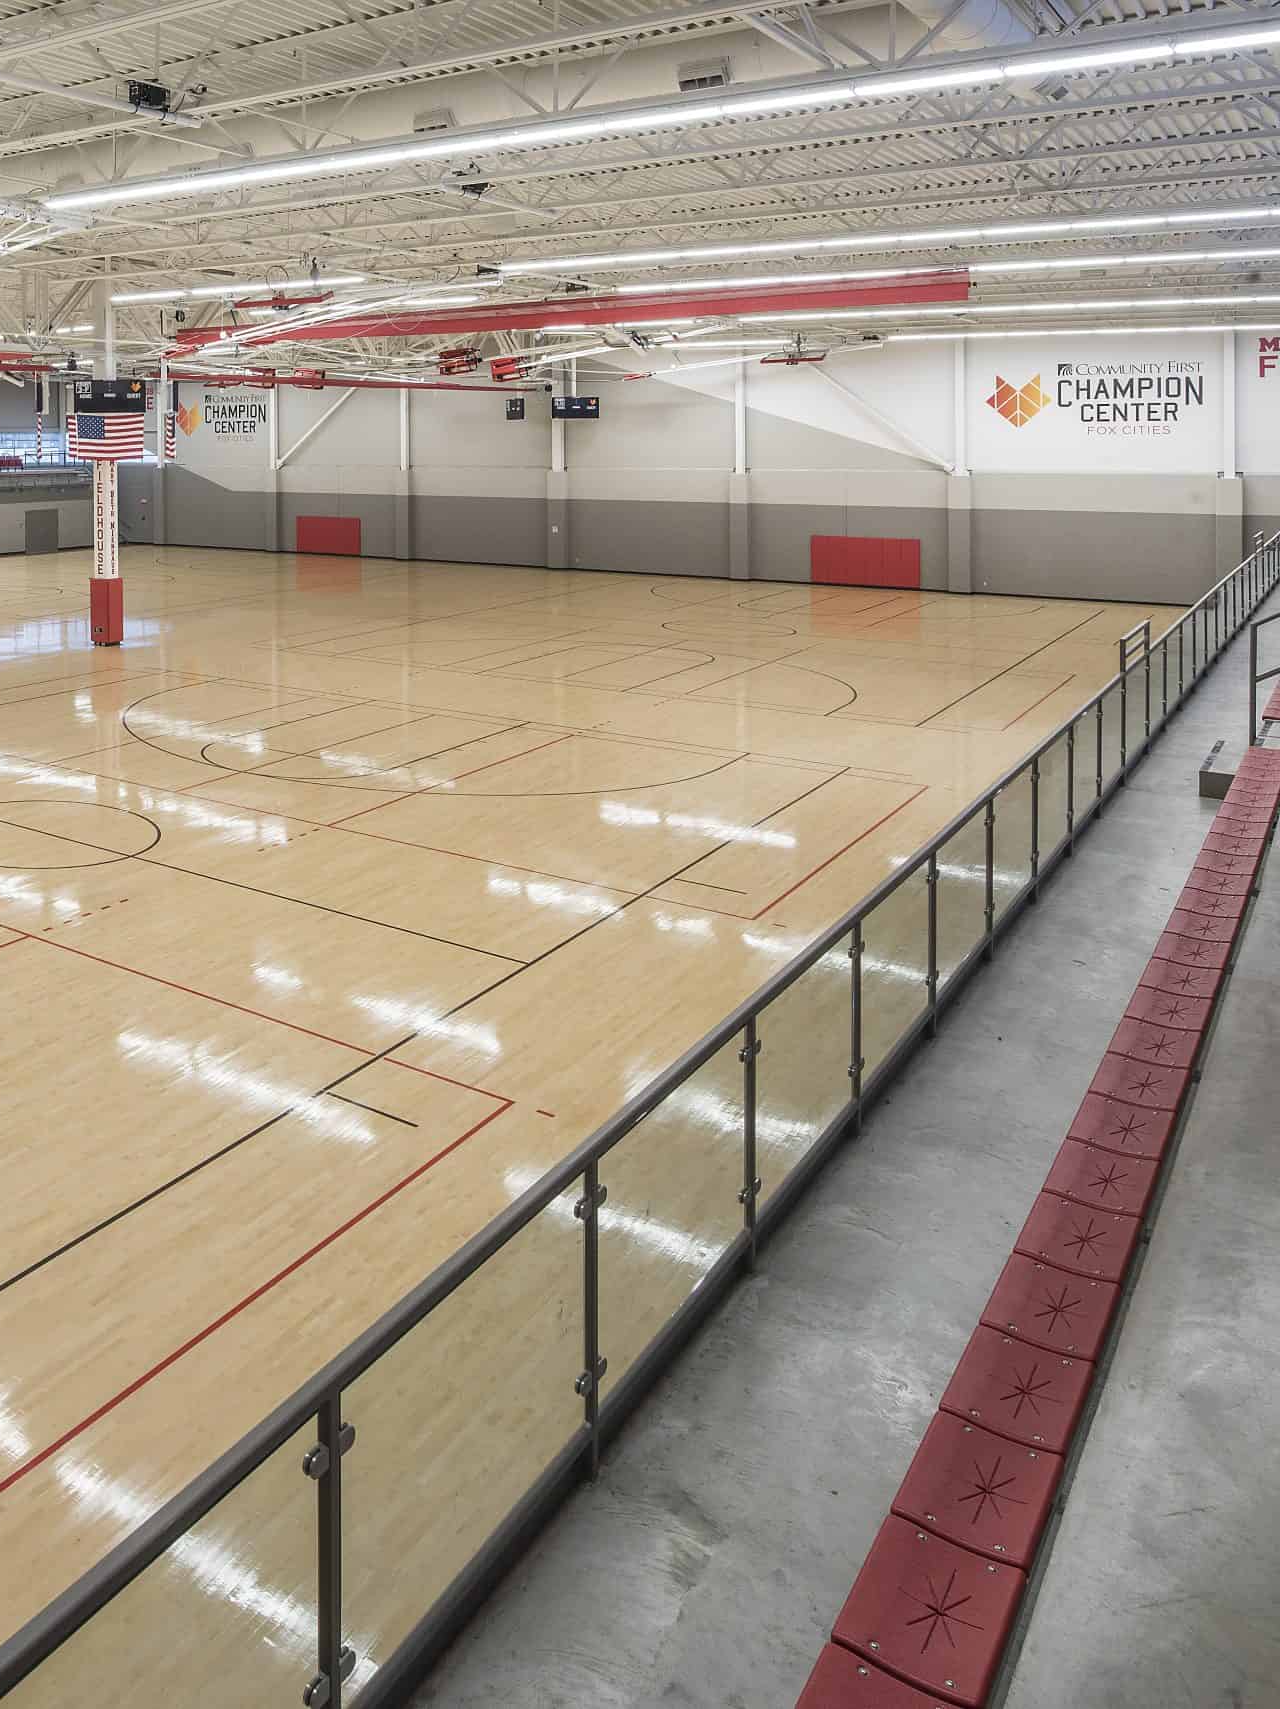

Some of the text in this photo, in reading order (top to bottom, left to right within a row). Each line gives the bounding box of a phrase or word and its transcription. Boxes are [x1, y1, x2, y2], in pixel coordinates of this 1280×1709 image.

[1075, 361, 1201, 376] COMMUNITY FIRST
[1057, 376, 1203, 407] CHAMPION
[205, 404, 266, 423] CHAMPION
[1080, 403, 1179, 422] CENTER
[214, 421, 256, 433] CENTER
[1087, 425, 1171, 435] FOX CITIES
[96, 461, 104, 575] FIELDHOUSE
